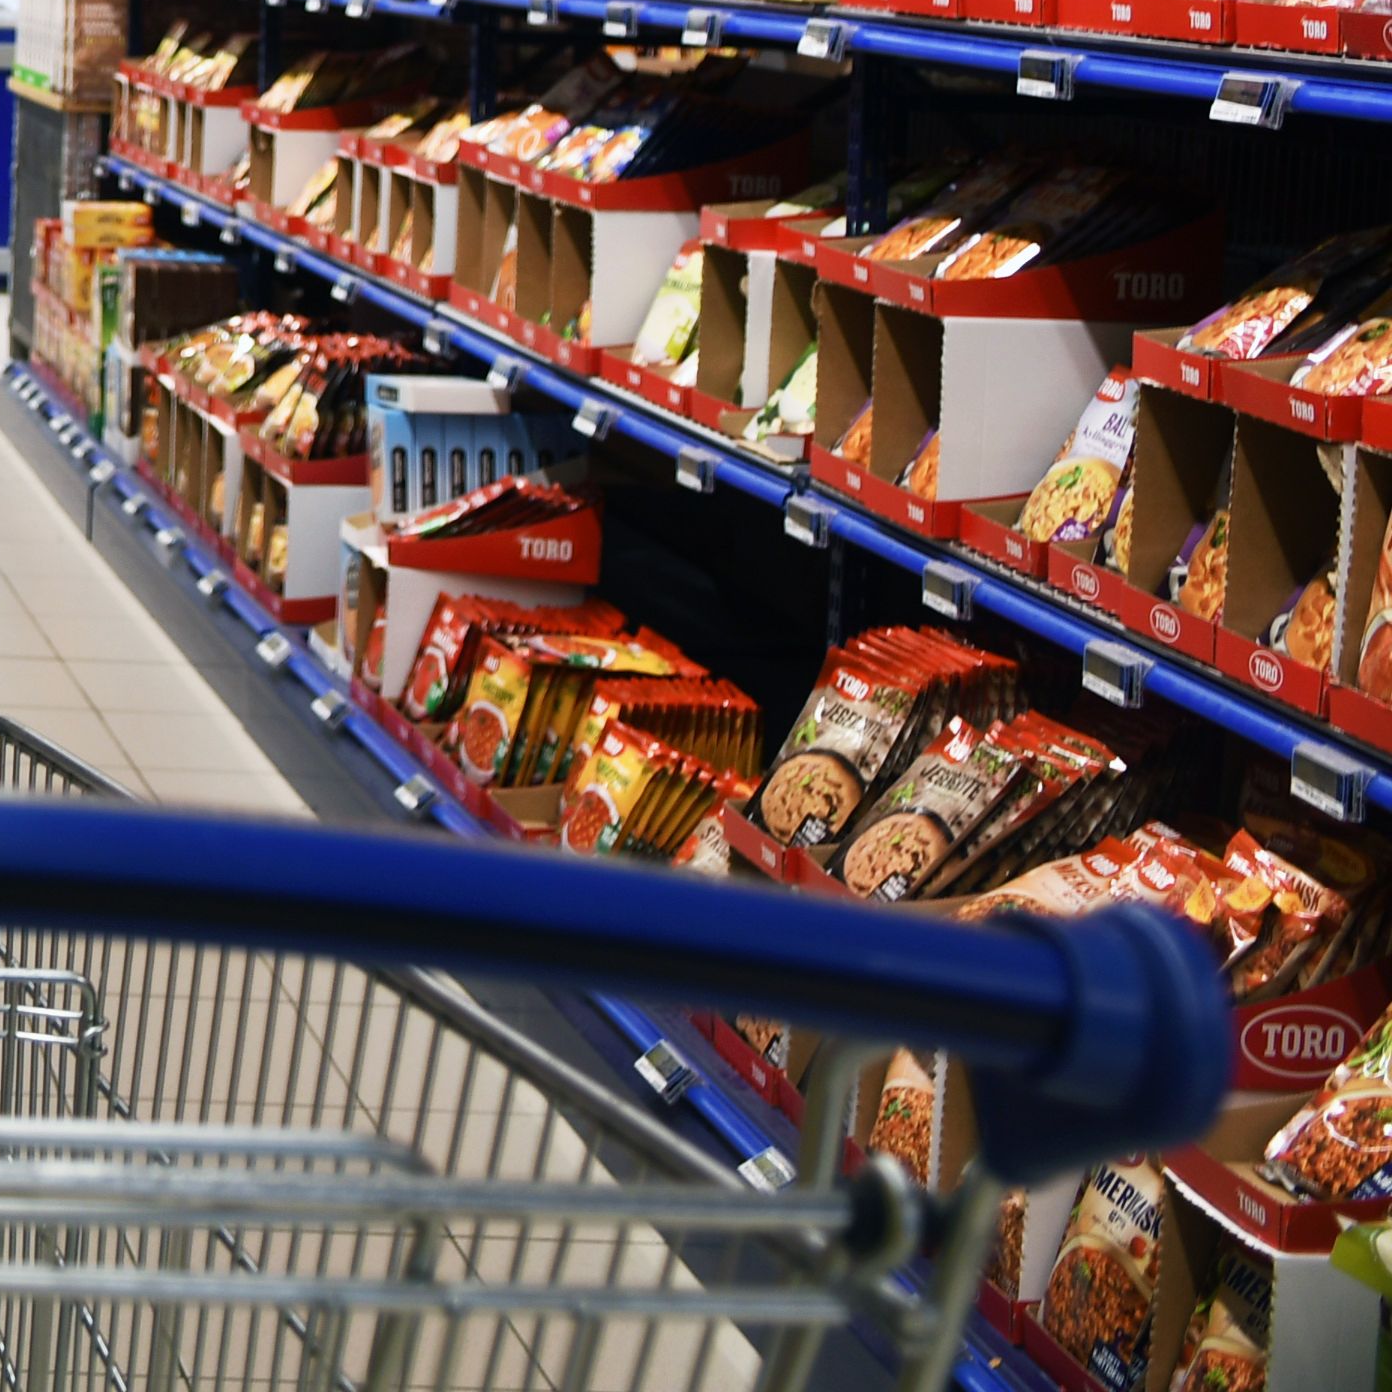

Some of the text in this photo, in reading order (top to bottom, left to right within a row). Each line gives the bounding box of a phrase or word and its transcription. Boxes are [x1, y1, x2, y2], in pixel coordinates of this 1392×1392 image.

[1111, 3, 1132, 22] TORO
[1189, 10, 1212, 30] TORO
[1302, 20, 1328, 40] TORO
[1180, 362, 1200, 387] TORO
[1290, 395, 1315, 422] TORO
[520, 537, 573, 563] TORO
[1153, 612, 1177, 636] TORO
[1253, 656, 1279, 685] TORO
[836, 671, 870, 701] TORO
[1262, 1023, 1346, 1059] TORO
[1237, 1186, 1267, 1226] TORO
